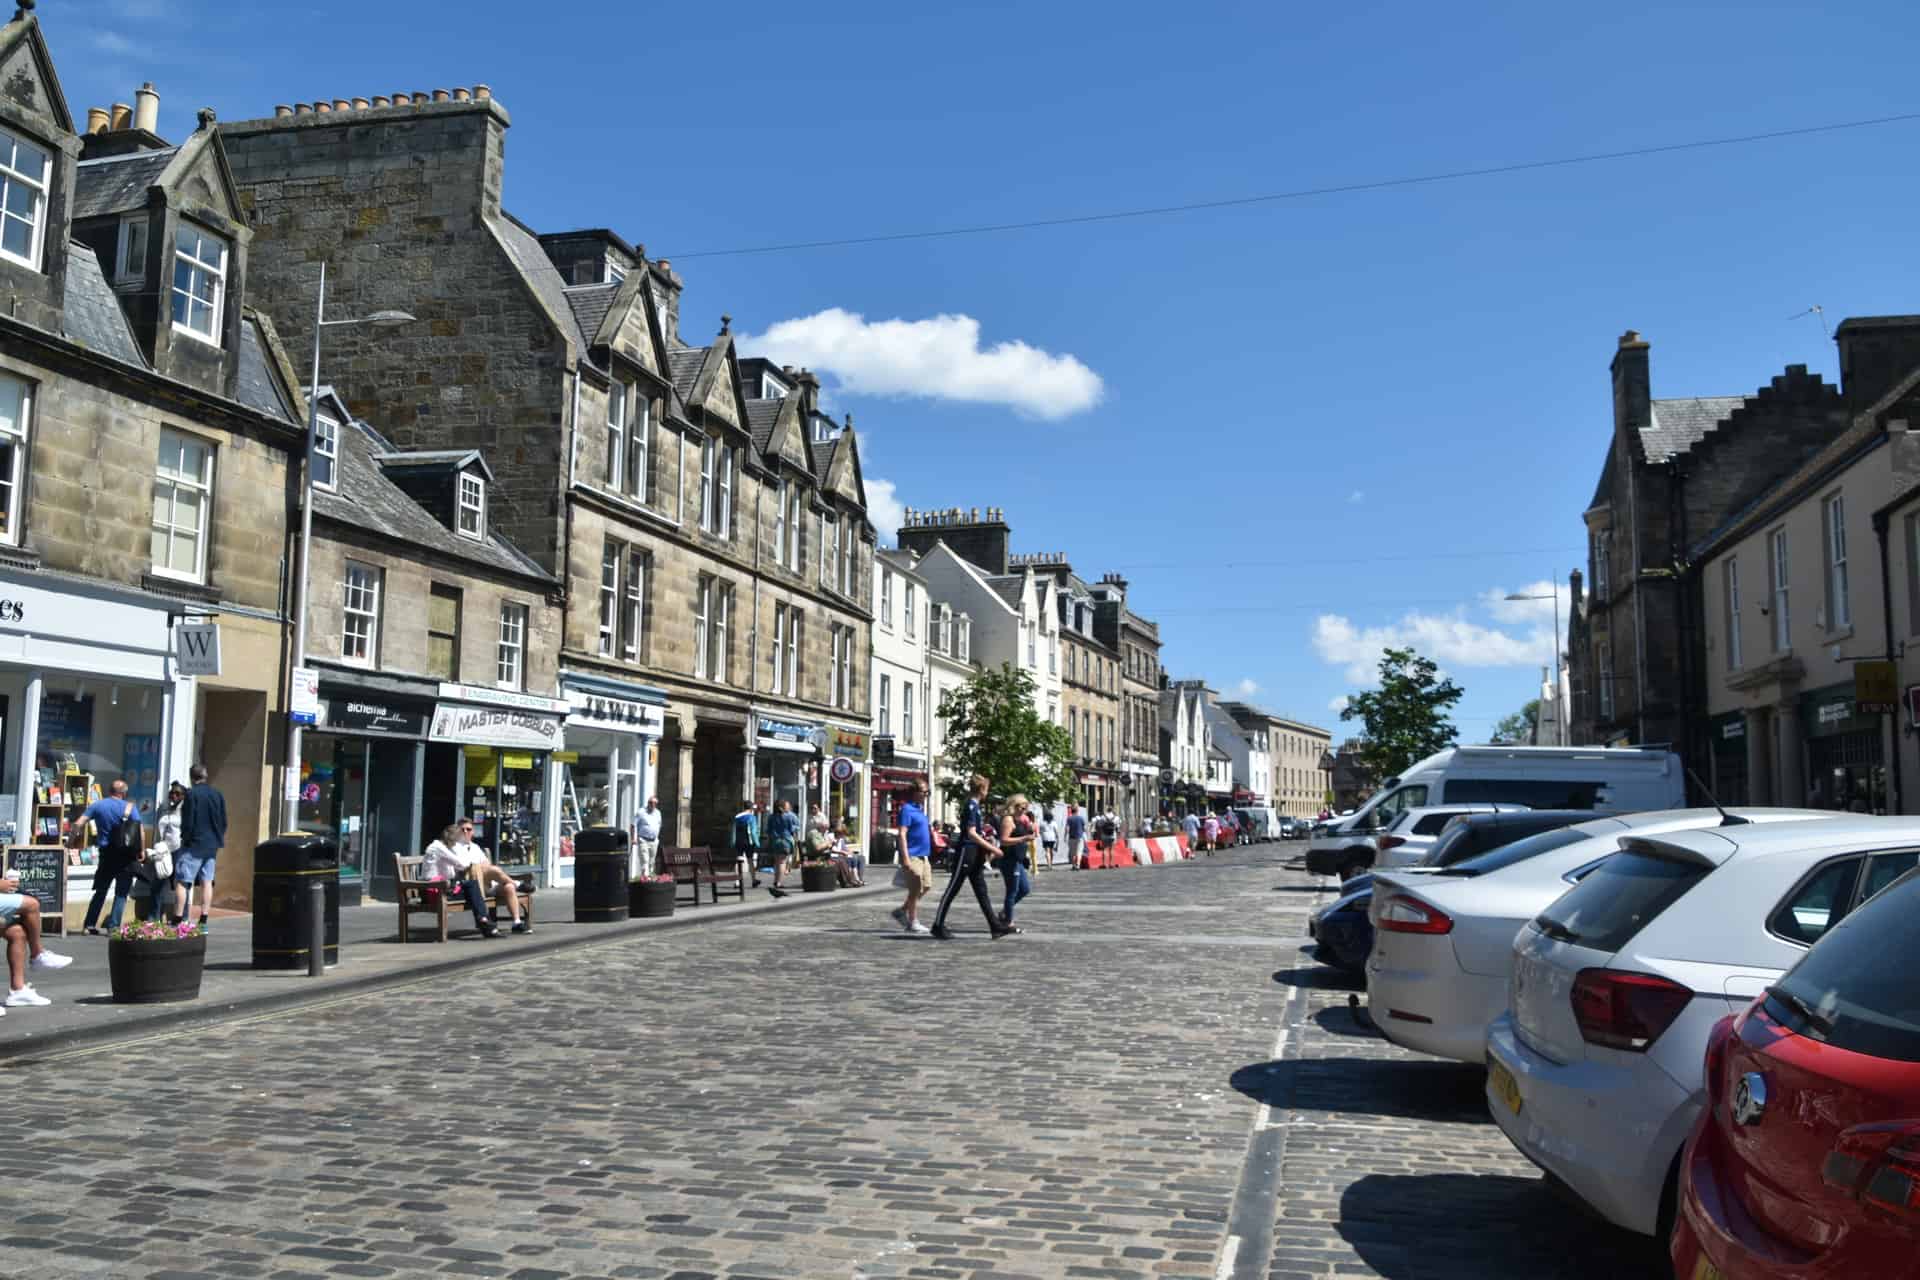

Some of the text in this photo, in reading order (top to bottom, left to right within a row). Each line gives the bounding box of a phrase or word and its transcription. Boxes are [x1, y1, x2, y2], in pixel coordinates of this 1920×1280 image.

[182, 631, 213, 657] W
[458, 709, 557, 738] MASTER COBBLER
[20, 867, 56, 881] ayflies
